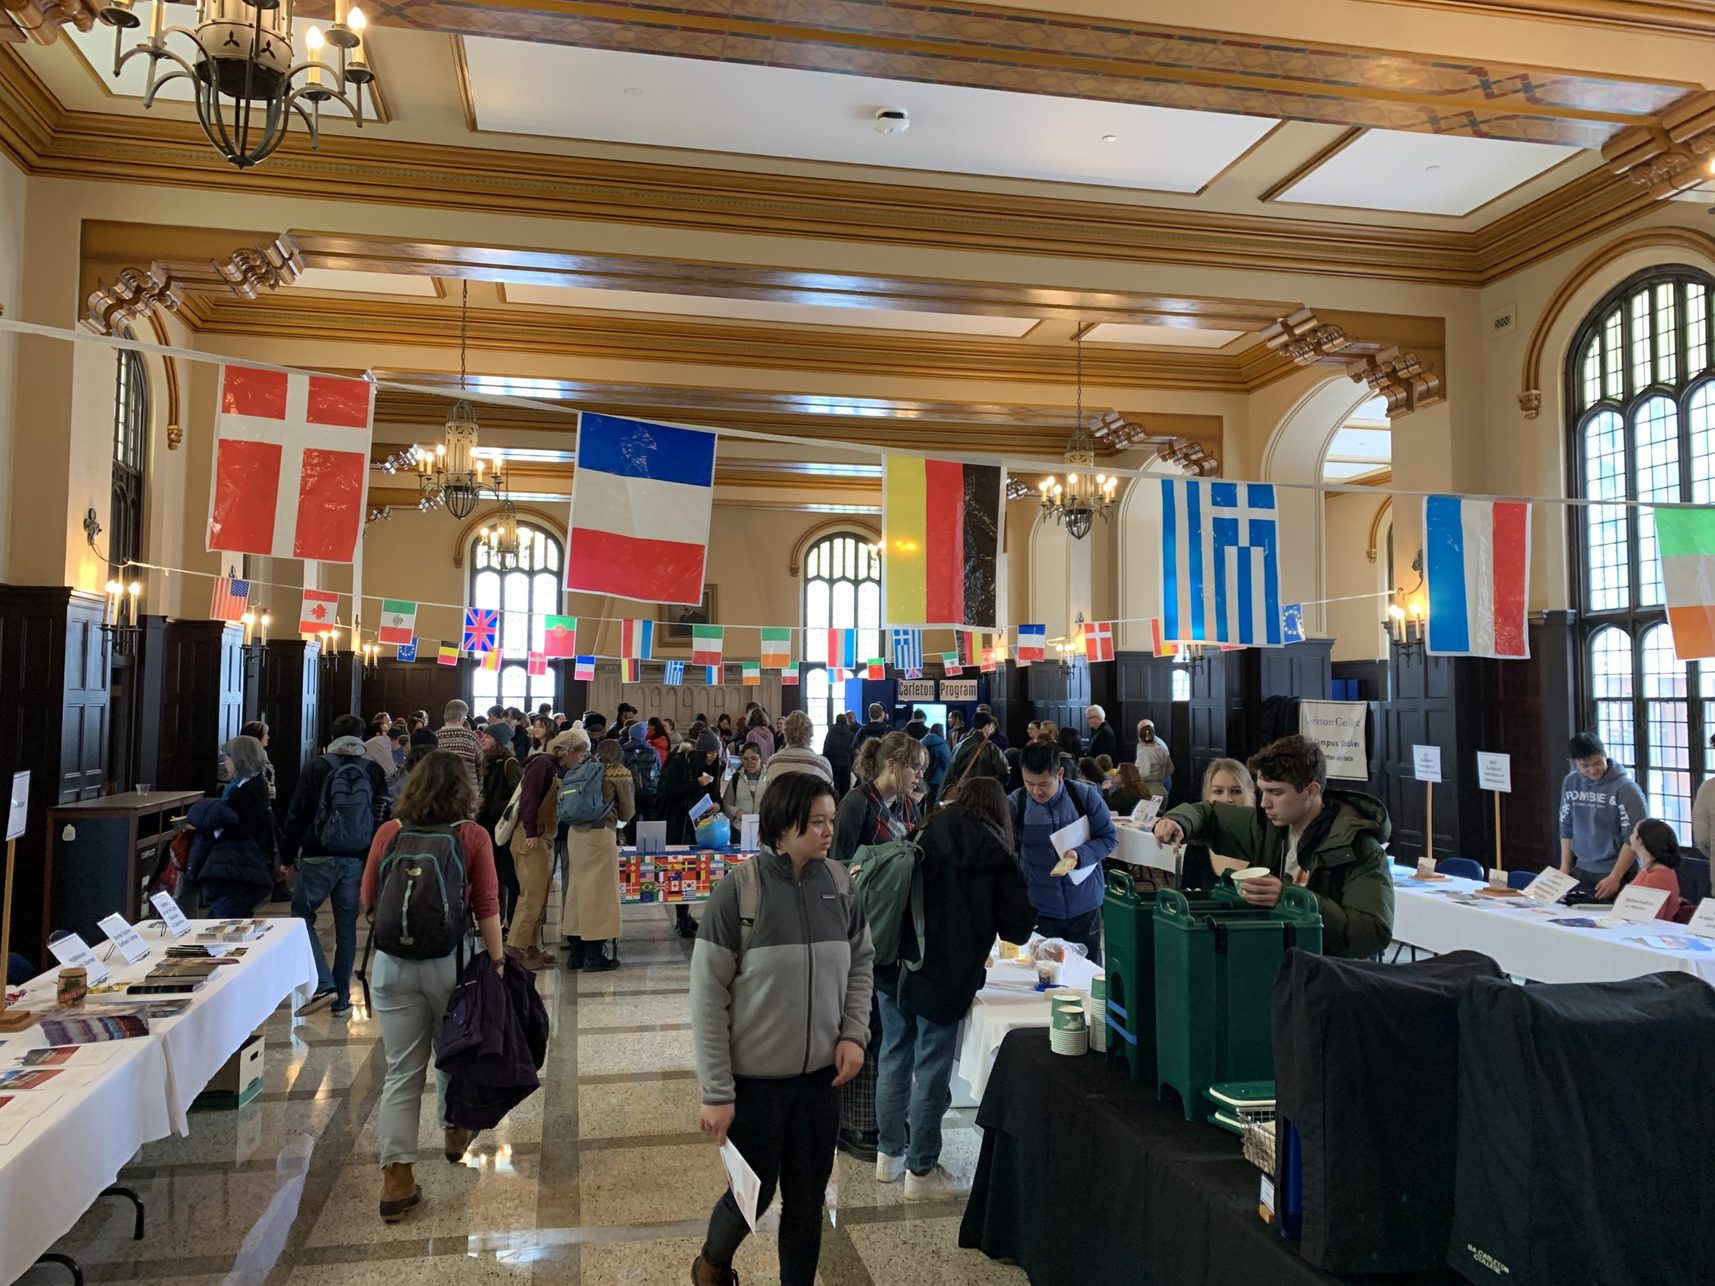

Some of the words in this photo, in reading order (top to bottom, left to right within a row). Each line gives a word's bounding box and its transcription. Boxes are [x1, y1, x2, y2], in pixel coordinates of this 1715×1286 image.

[899, 682, 934, 696] Carleton
[940, 682, 977, 699] Program
[1609, 795, 1618, 806] &
